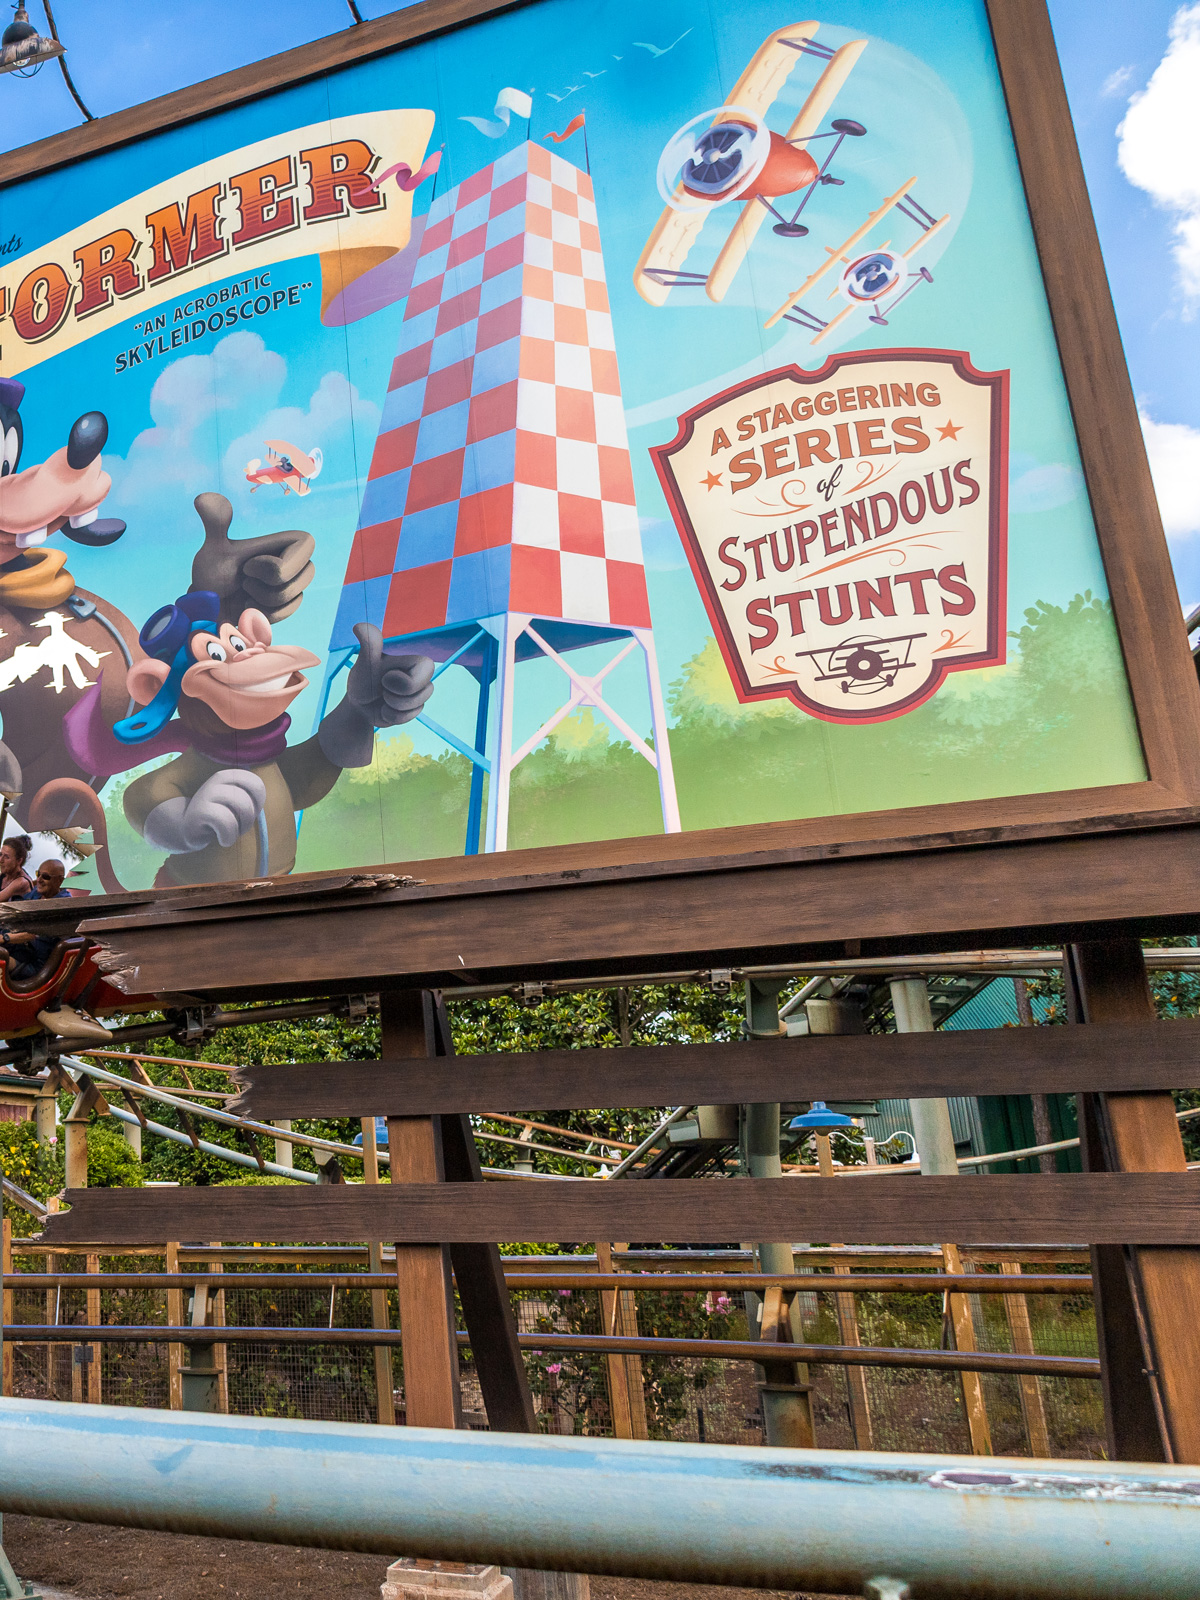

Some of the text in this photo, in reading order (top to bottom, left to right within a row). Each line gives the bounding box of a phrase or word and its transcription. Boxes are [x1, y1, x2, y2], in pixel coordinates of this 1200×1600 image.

[173, 272, 272, 321] ACROBATIC
[711, 382, 941, 456] A STAGGERING
[728, 416, 931, 495] SERIES
[816, 463, 844, 502] of
[717, 458, 981, 592] STUPENDOUS
[745, 561, 977, 656] STUNTS
